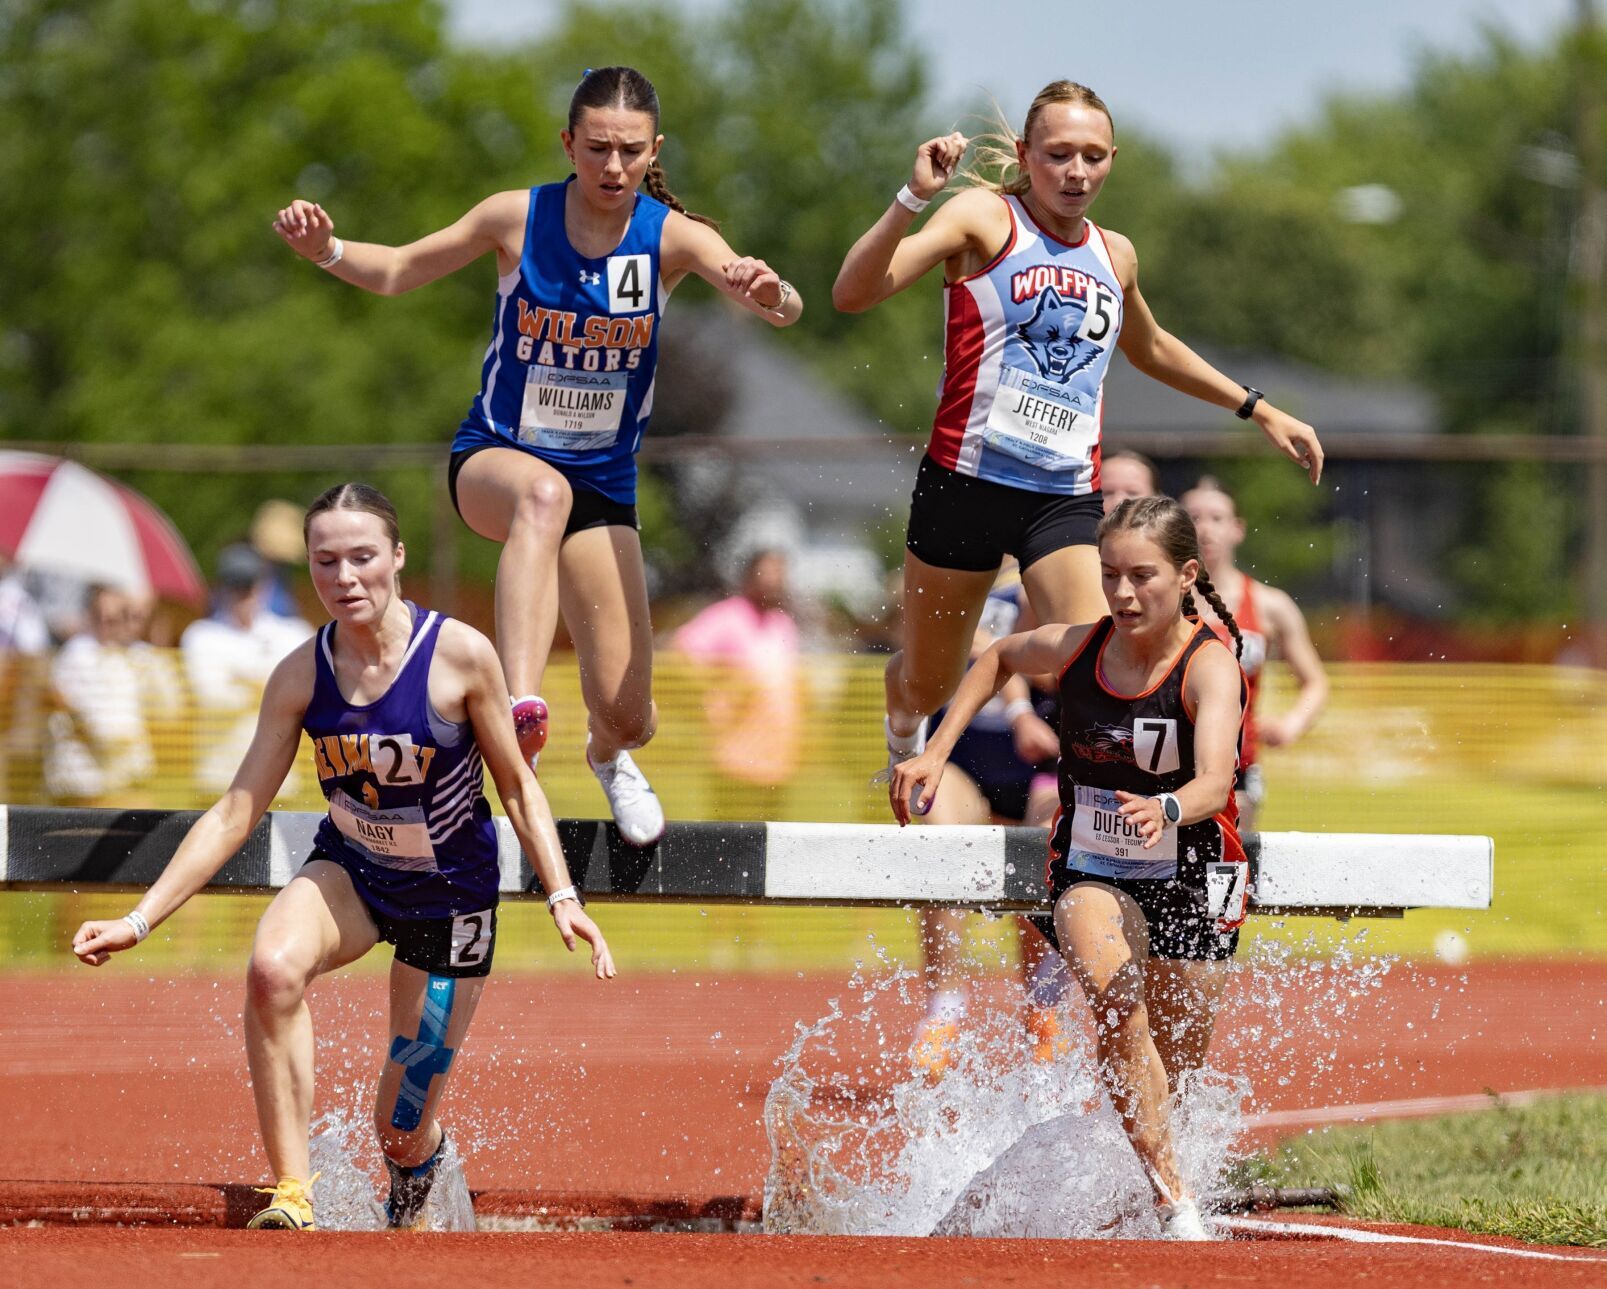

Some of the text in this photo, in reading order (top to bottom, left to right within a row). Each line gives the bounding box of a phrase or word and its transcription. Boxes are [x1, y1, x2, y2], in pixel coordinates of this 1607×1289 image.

[616, 259, 644, 308] 4
[517, 297, 655, 349] WILSON
[1086, 291, 1112, 341] 5
[516, 335, 642, 372] GATORS
[547, 373, 611, 385] OFSAA
[1021, 378, 1082, 406] OFSAA
[538, 387, 614, 411] WILLIAMS
[1012, 394, 1078, 432] JEFFERY
[564, 419, 583, 430] 1719
[1024, 419, 1058, 435] WEST NIAGARA
[1029, 431, 1049, 445] 1208
[378, 738, 412, 783] 2
[1142, 722, 1167, 772] 7
[356, 818, 393, 840] NAGY
[1093, 810, 1150, 838] DUFOU
[371, 844, 390, 854] 1842
[1115, 847, 1129, 857] 391
[1215, 866, 1239, 917] 7
[458, 915, 483, 962] 2
